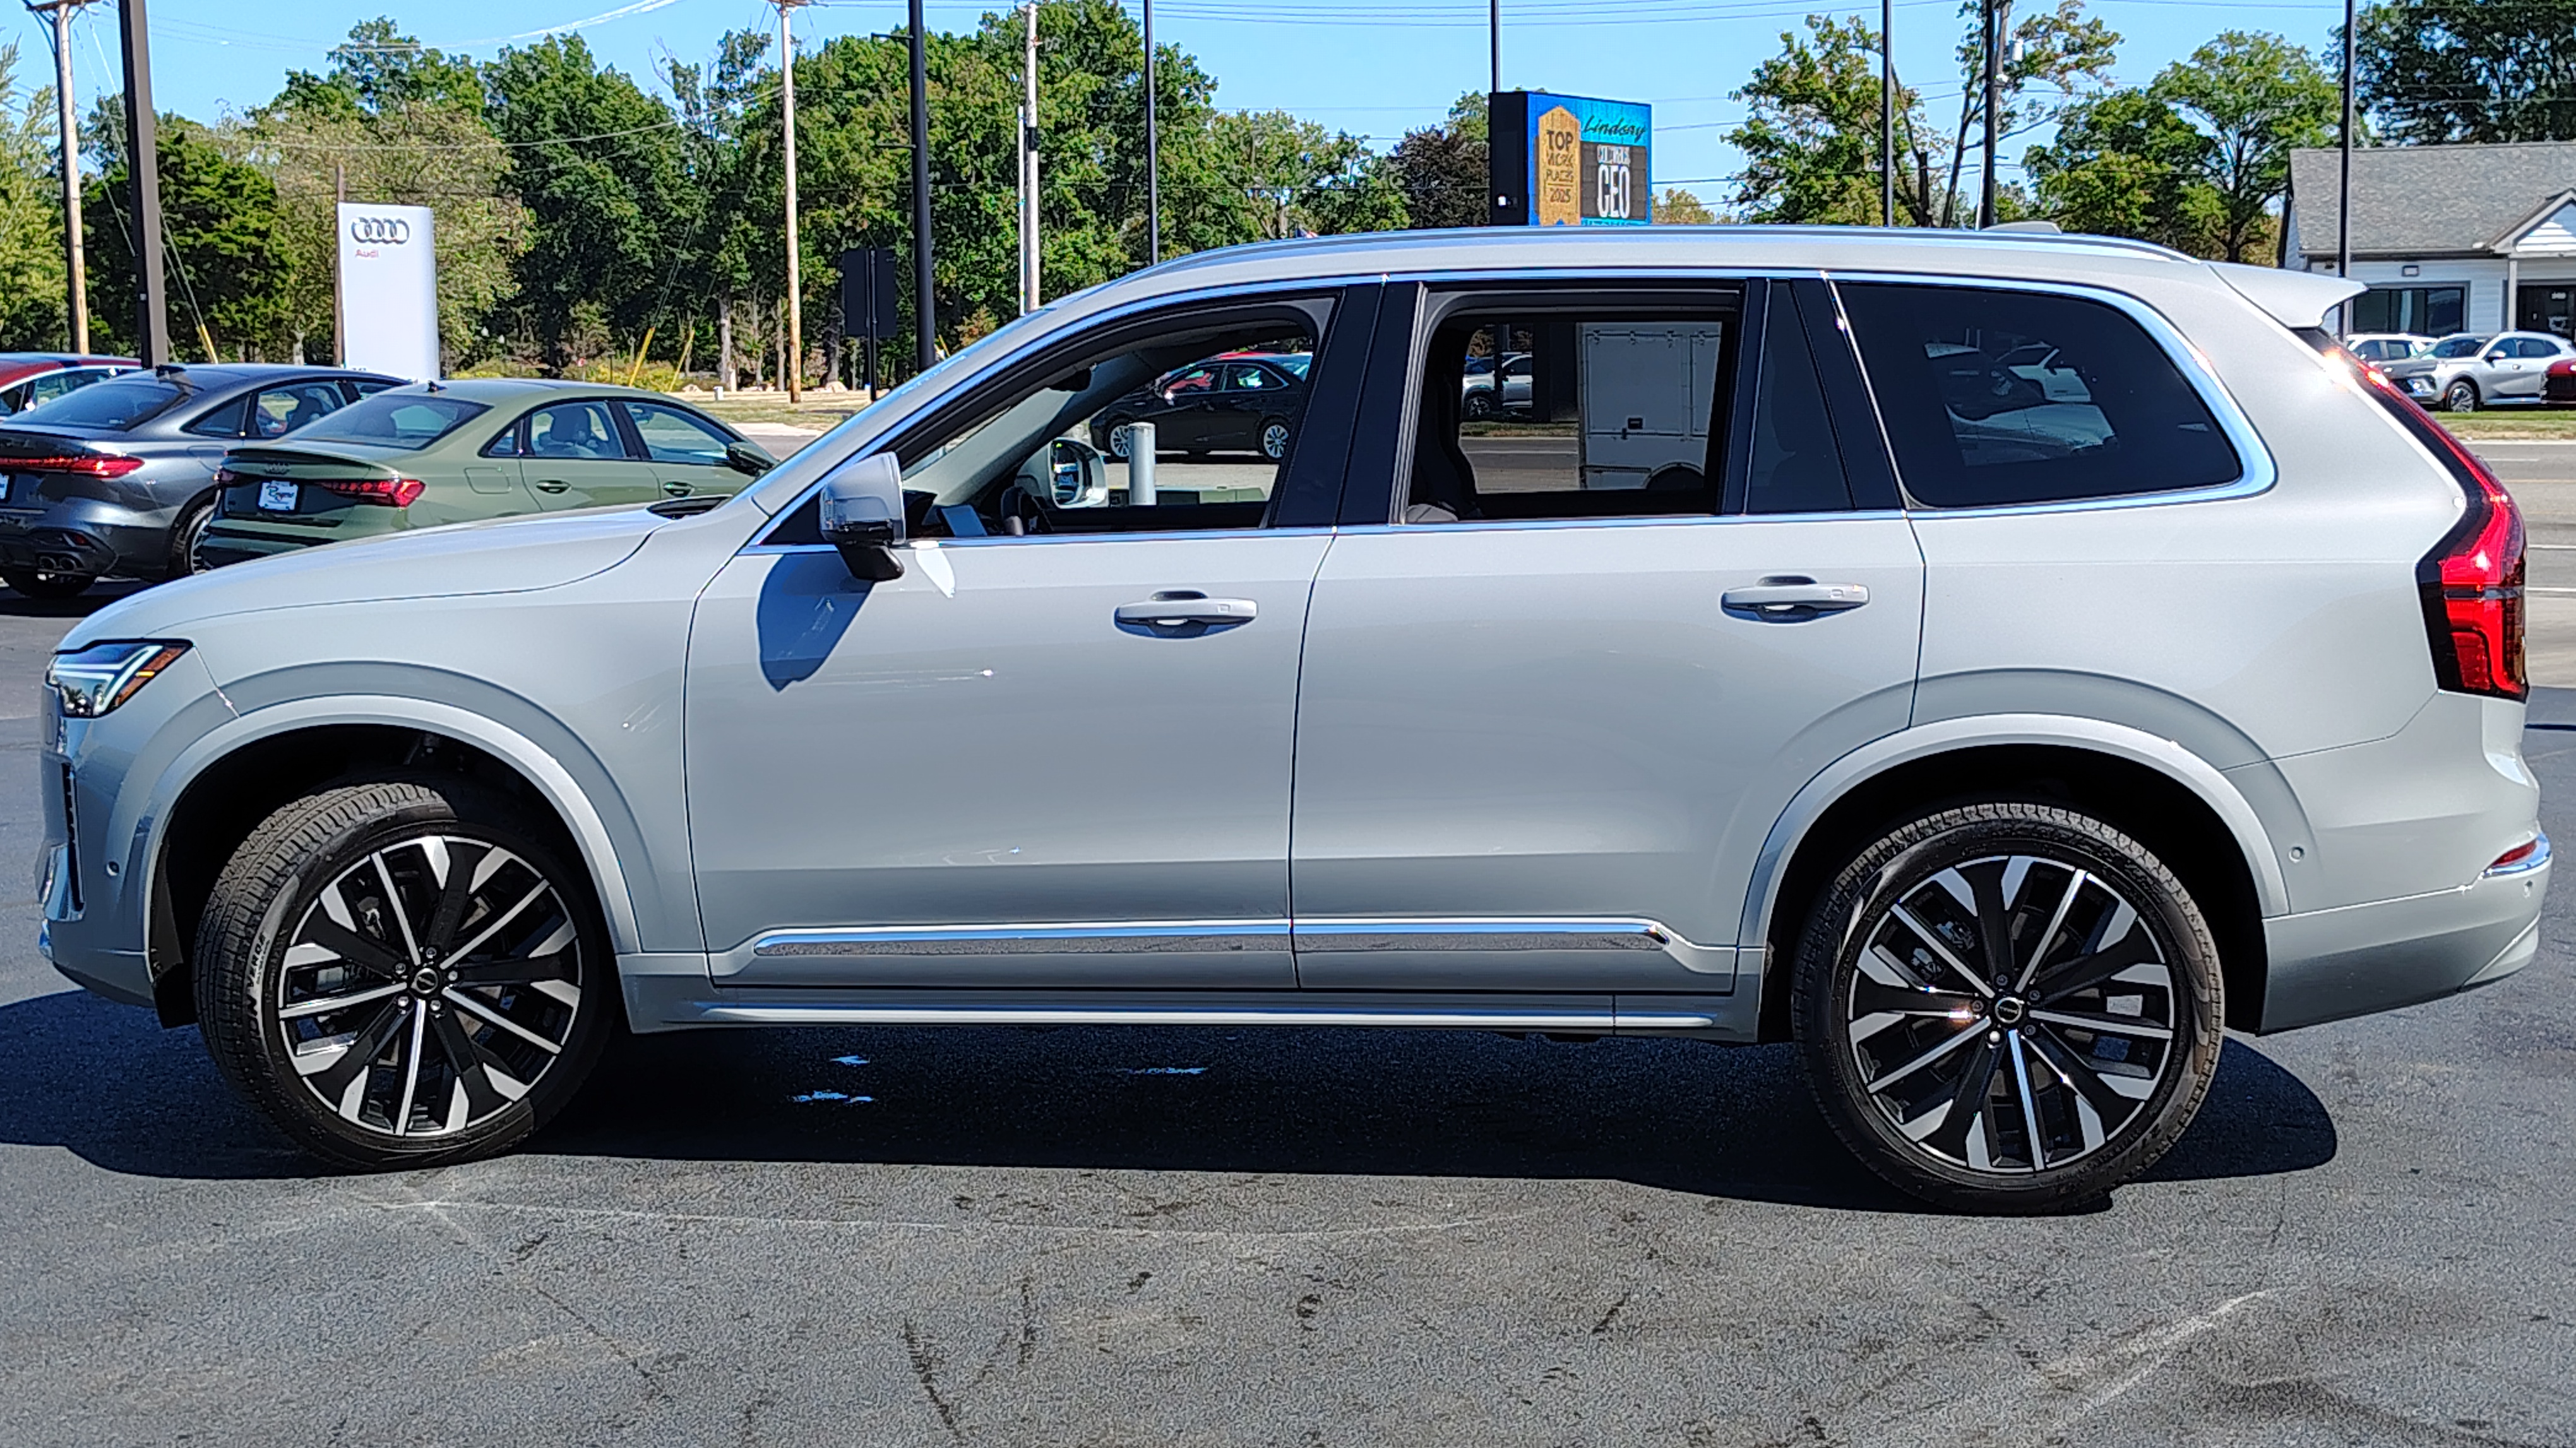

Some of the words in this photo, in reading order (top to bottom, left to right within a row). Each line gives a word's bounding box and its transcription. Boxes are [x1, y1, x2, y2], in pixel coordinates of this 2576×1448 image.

[1546, 129, 1574, 151] TOP
[1584, 115, 1647, 143] Lindsay
[1598, 164, 1630, 219] CEO
[355, 249, 379, 258] Audi
